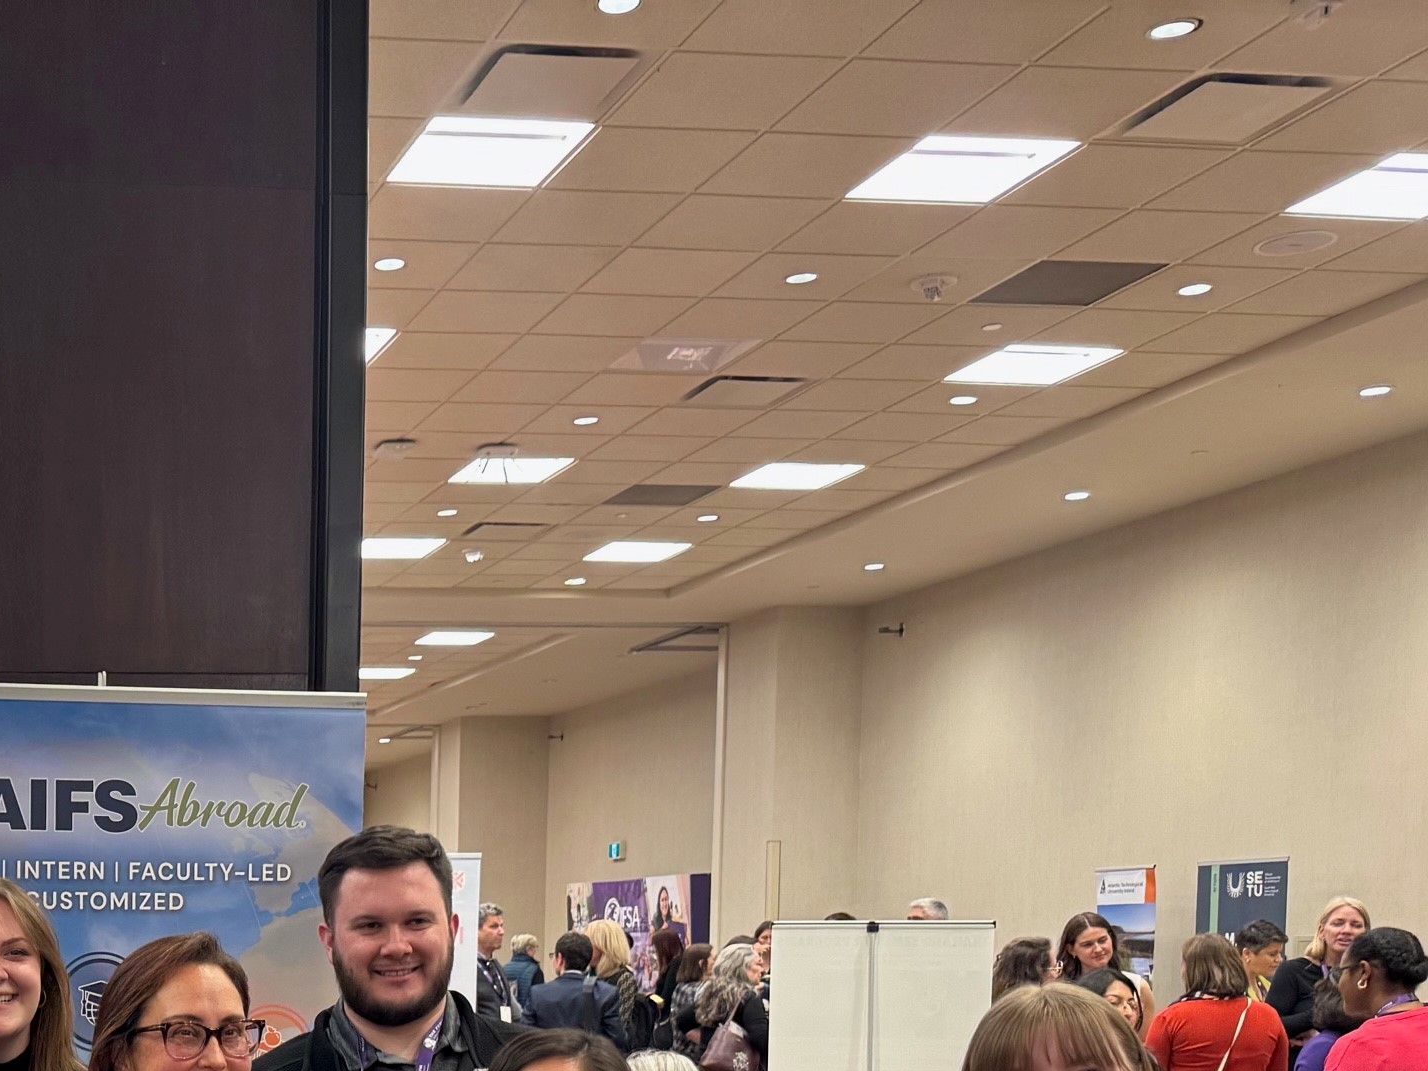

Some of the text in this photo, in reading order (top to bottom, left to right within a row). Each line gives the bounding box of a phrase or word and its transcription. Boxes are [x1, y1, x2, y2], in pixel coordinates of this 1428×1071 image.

[138, 777, 309, 832] Abroad
[16, 860, 105, 881] INTERN
[128, 861, 292, 882] FACULTY-LED
[1246, 870, 1264, 884] SE
[1246, 884, 1263, 897] TU
